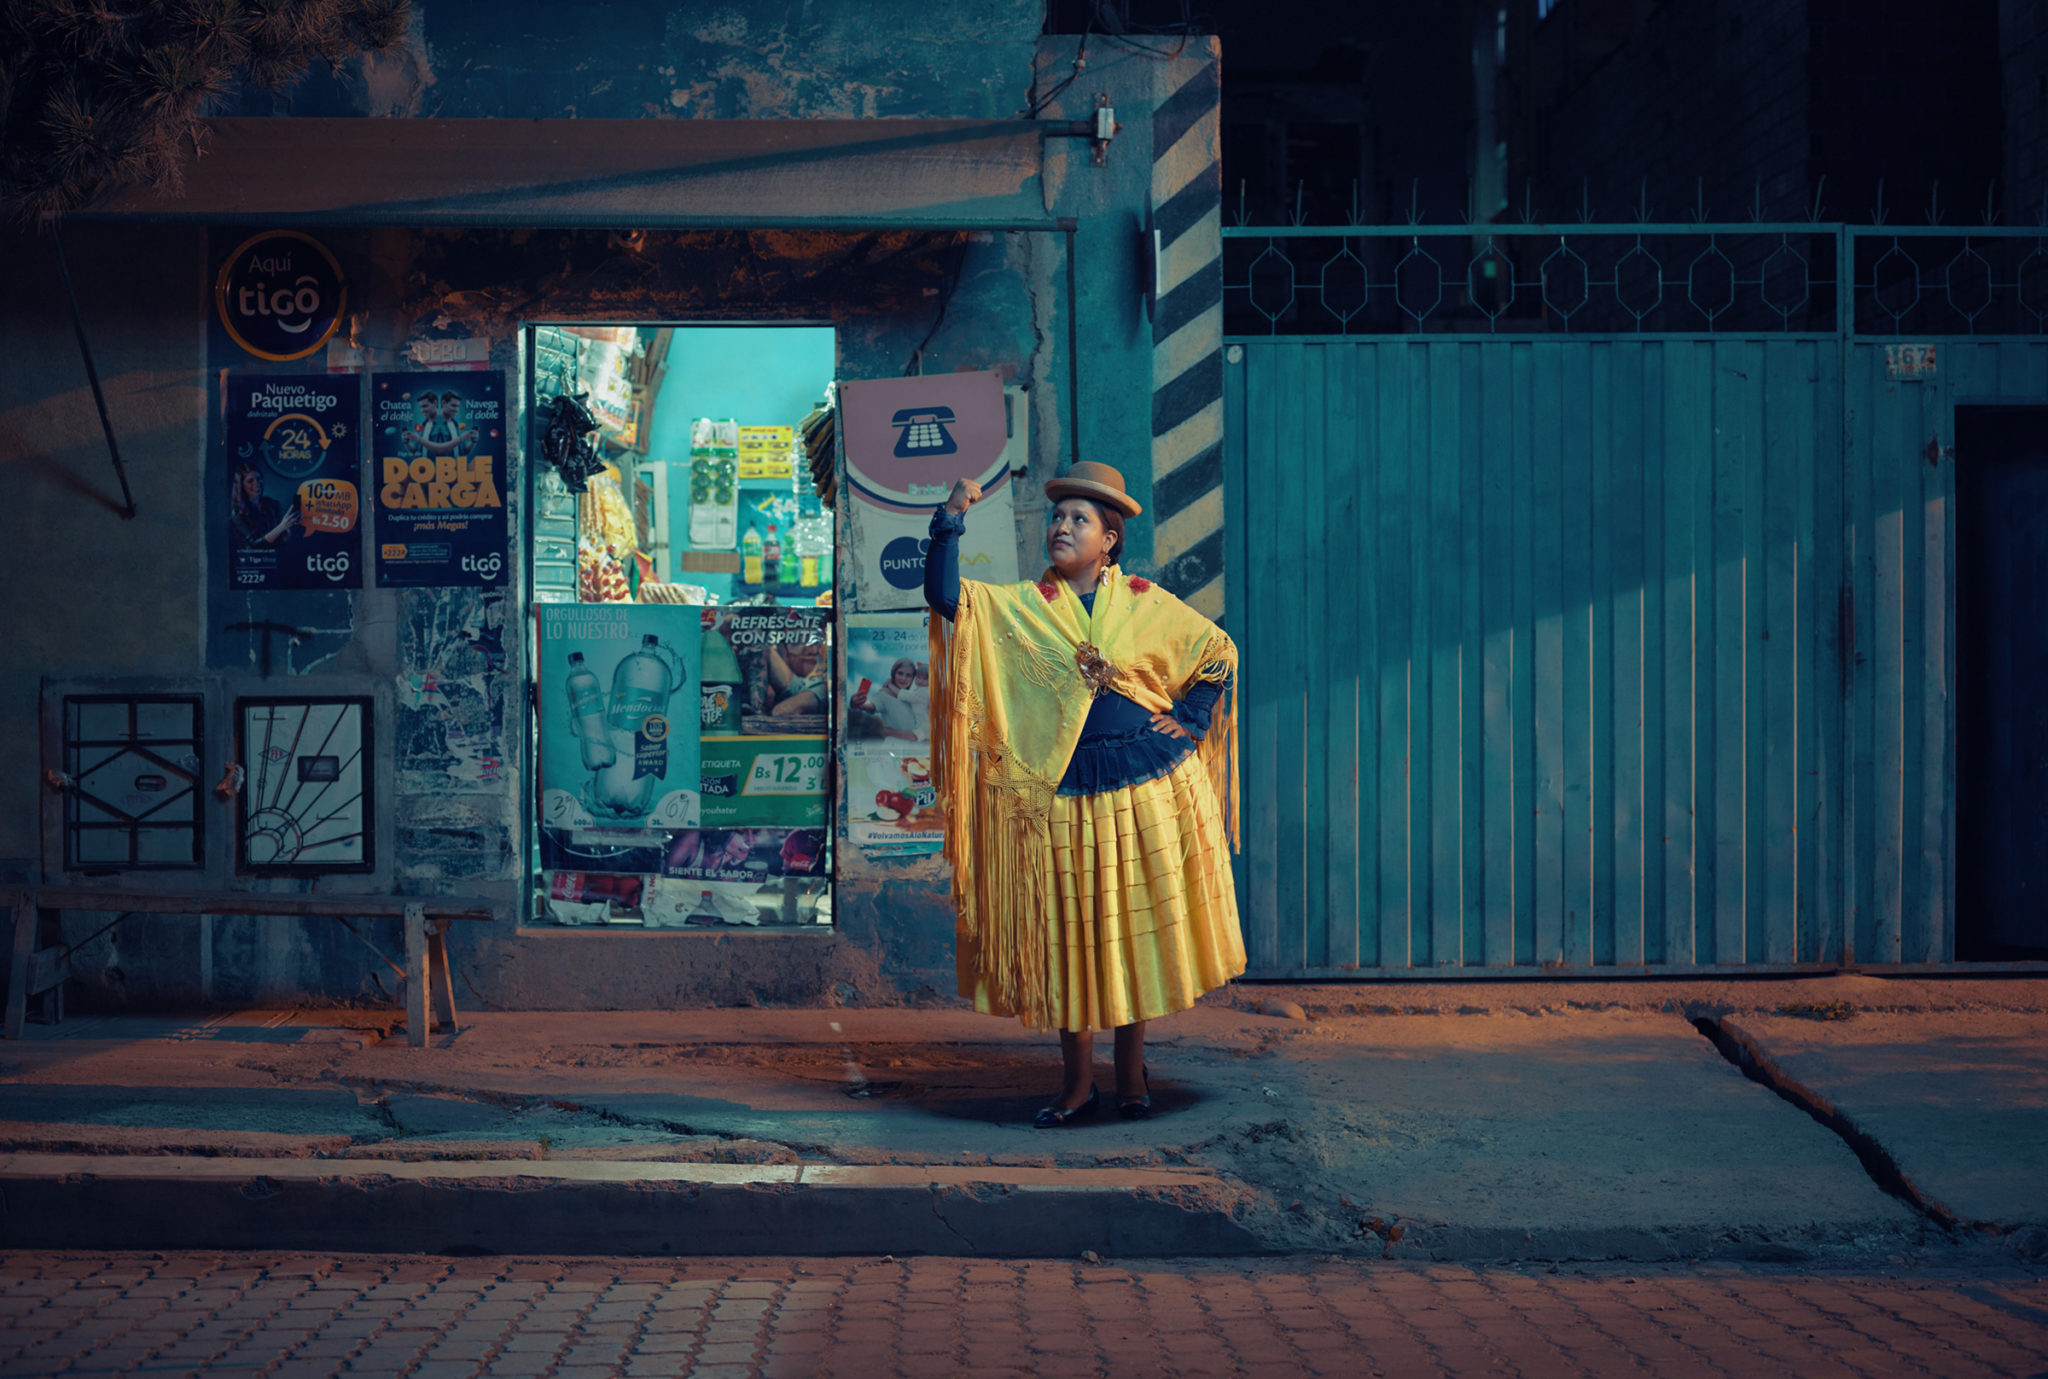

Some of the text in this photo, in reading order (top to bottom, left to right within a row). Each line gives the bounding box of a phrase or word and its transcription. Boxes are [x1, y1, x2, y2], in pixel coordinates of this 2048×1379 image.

[248, 251, 293, 277] Aquí
[265, 383, 306, 396] Nuevo
[251, 390, 338, 413] Paquetigo
[379, 399, 412, 411] Chatea
[465, 399, 499, 411] Navega
[380, 410, 414, 422] el doble
[465, 409, 499, 420] el doble
[281, 428, 311, 451] 24
[278, 450, 312, 460] HORAS
[383, 455, 494, 484] DOBLE
[307, 483, 351, 501] 100 MB
[380, 481, 503, 509] CARGA
[908, 481, 947, 497] Entel
[322, 513, 350, 529] 2.50
[306, 551, 350, 582] tigo
[461, 552, 501, 581] tigo
[545, 607, 629, 621] ORGULLOSOS DE
[546, 622, 629, 640] LO NUESTRO
[731, 630, 819, 645] CON SPRITE
[872, 631, 886, 641] 23
[894, 631, 907, 641] 24
[638, 759, 664, 767] AWARD
[701, 759, 742, 769] ETIQUETA
[755, 766, 771, 779] Bs
[805, 777, 816, 790] 3
[916, 791, 932, 806] Pil
[668, 867, 754, 879] SIENTE EL SABOR
